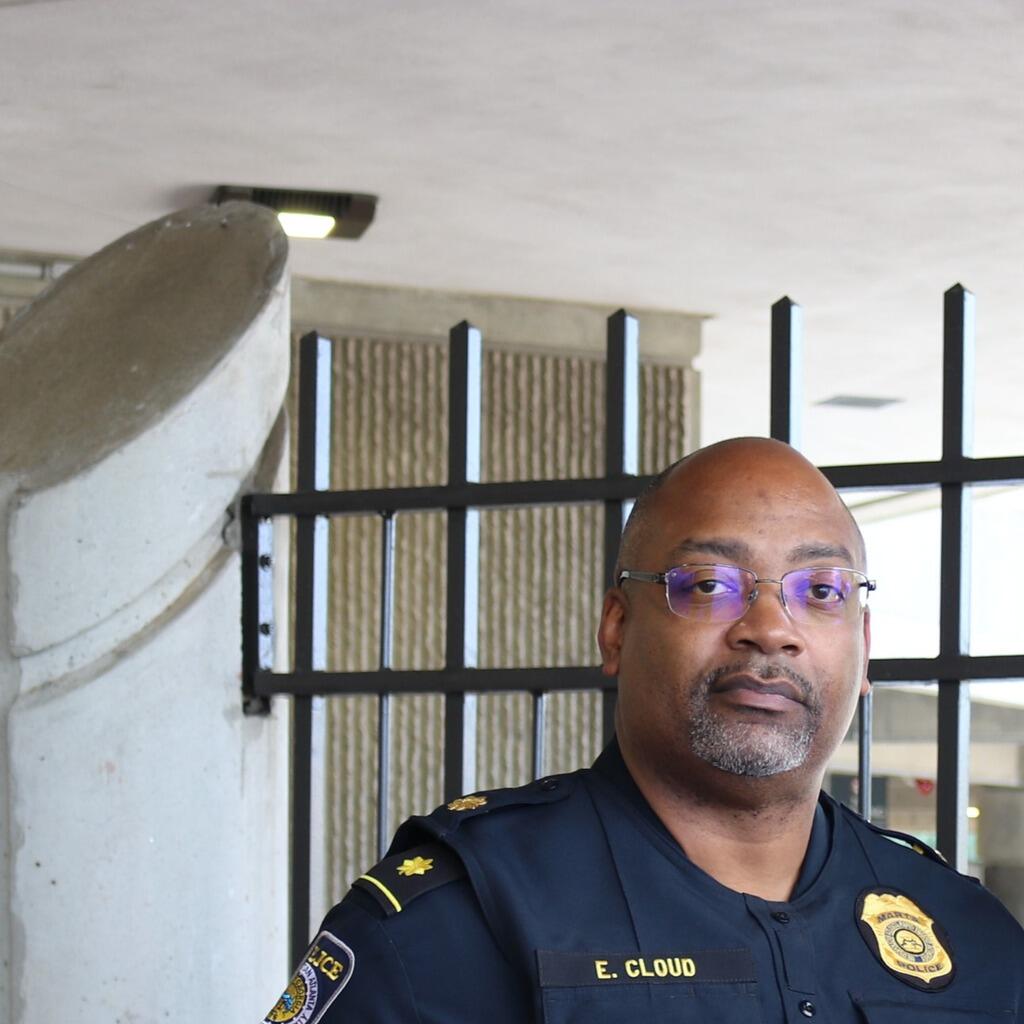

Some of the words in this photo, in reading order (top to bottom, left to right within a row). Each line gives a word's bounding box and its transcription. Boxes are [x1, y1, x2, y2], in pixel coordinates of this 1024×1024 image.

[308, 945, 344, 981] LICE
[594, 960, 618, 979] E.
[625, 958, 696, 978] CLOUD
[896, 959, 944, 973] POLICE
